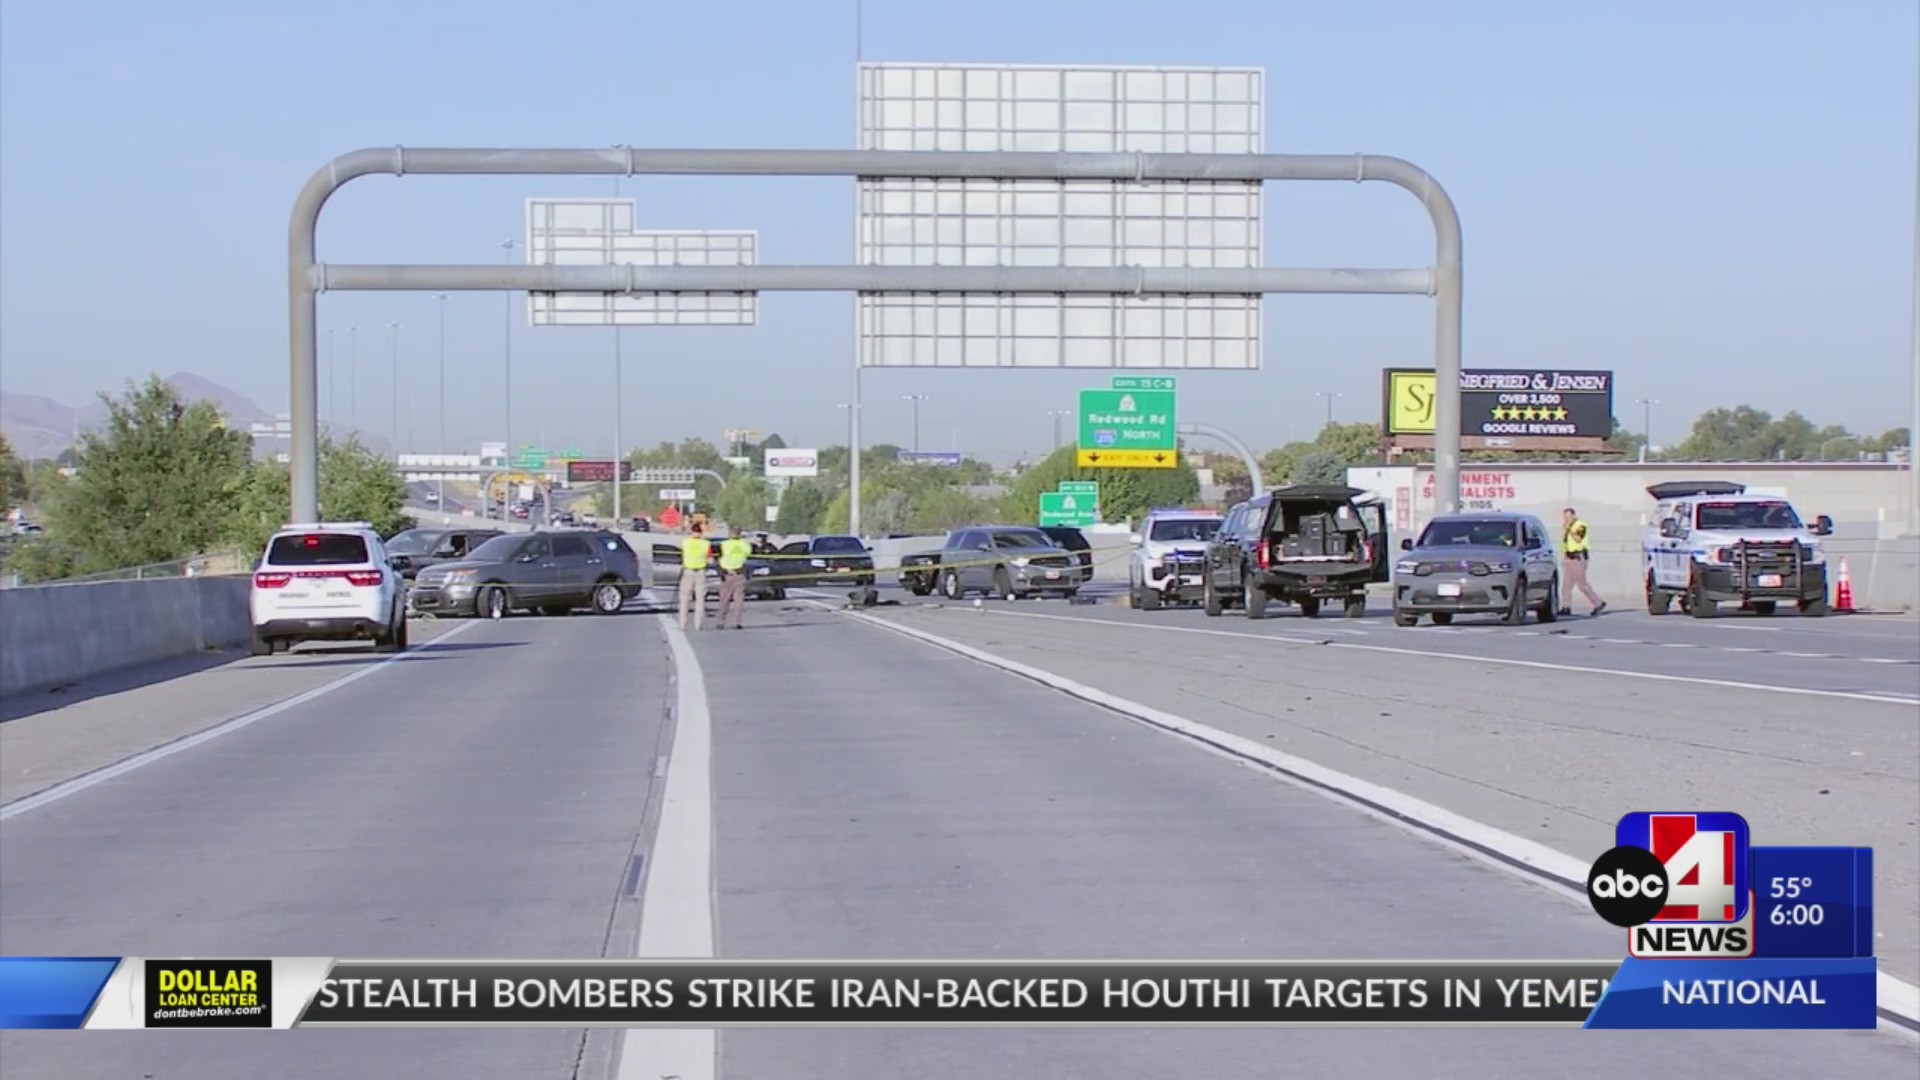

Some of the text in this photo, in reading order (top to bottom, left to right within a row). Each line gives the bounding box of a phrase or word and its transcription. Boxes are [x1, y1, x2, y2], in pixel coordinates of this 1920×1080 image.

[1531, 373, 1548, 390] &
[1550, 373, 1606, 391] JENSEN
[1499, 394, 1560, 405] OVER 3,500
[1089, 413, 1166, 425] Redwood Rd
[1483, 423, 1576, 434] GOOGLE REVIEWS
[1123, 429, 1161, 440] NORTH
[1428, 474, 1510, 484] ANMENT
[1423, 487, 1515, 498] SIALISTS
